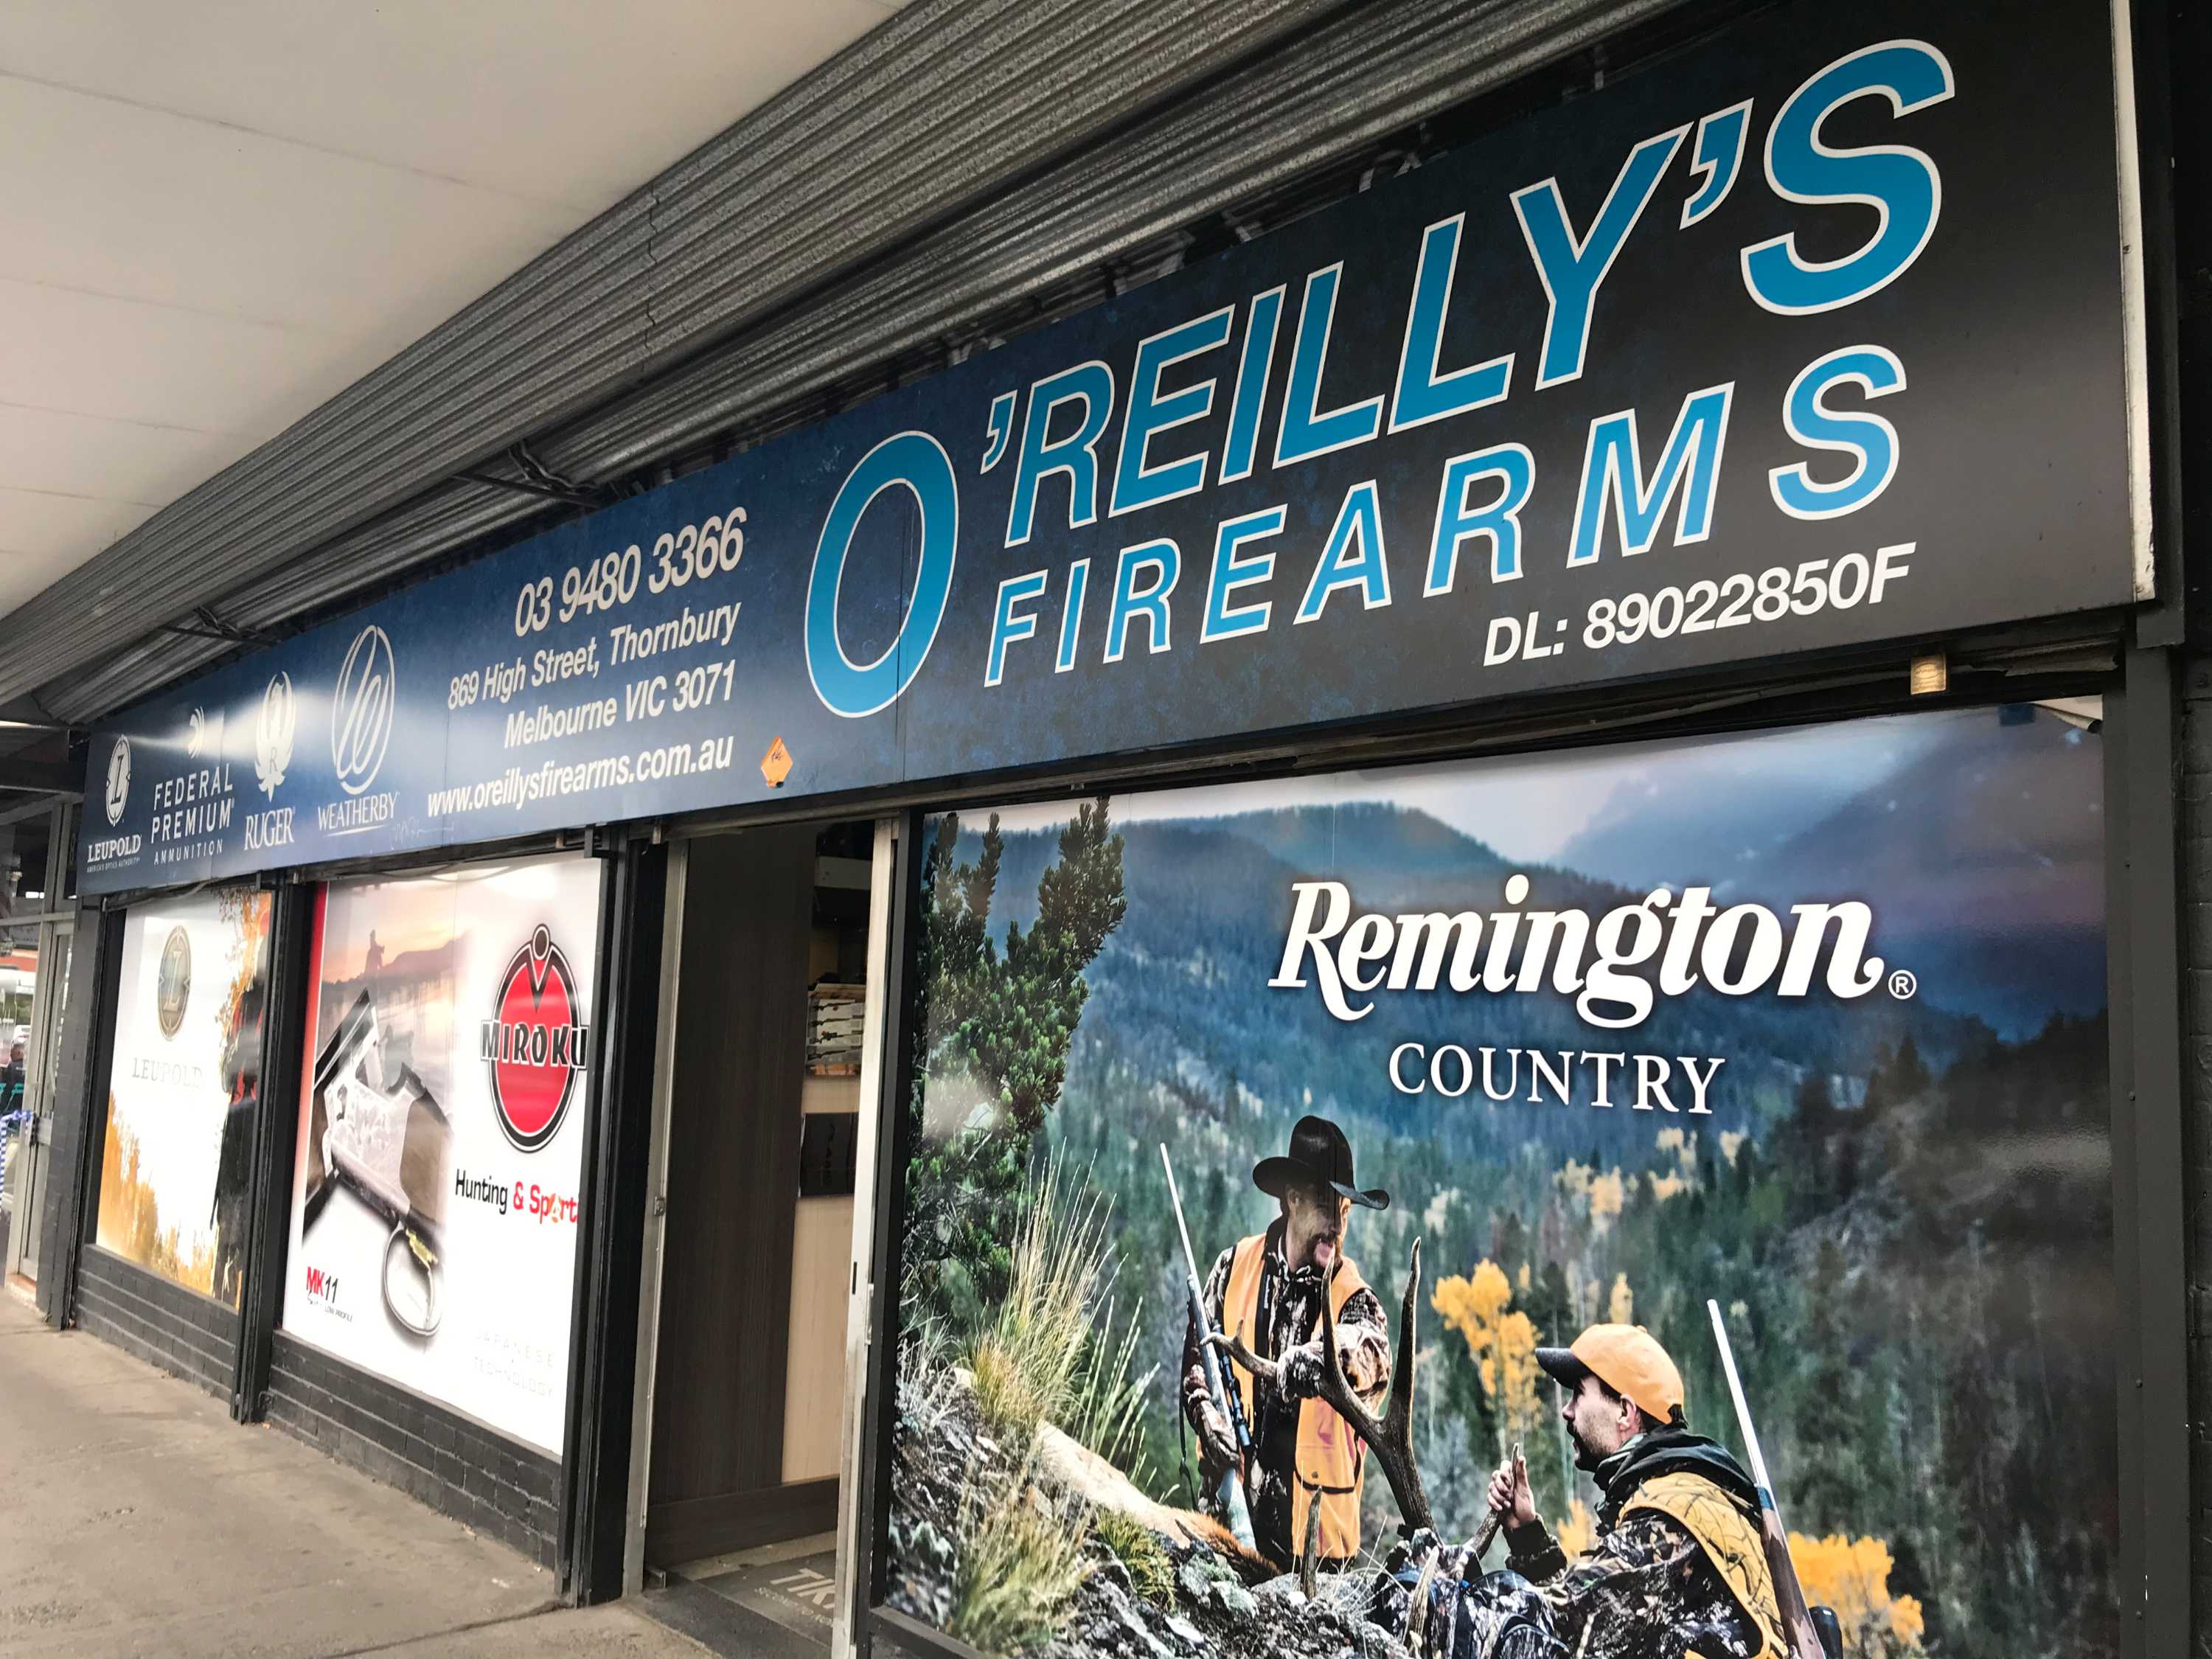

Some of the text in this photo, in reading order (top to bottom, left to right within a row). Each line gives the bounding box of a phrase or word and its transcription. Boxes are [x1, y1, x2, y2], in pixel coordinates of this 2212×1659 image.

[804, 38, 1955, 719] O'REILLY'S
[983, 344, 1907, 688] FIREARMS
[515, 507, 747, 636] 03 9480 3366
[1483, 542, 1916, 667] DL: 89022850F
[448, 602, 742, 710] 869 High Street, Thornbury
[504, 659, 736, 749] Melbourne VIC 3071
[153, 763, 234, 811] FEDERAL
[427, 735, 734, 818] www.oreillysfirearms.com.au
[151, 799, 231, 844] PREMIUM
[244, 807, 295, 851] RUGER
[318, 791, 399, 831] WEATHERBY
[87, 834, 142, 863] LEUPOLD
[153, 838, 223, 866] AMMUNITION
[1267, 874, 1885, 1029] Remington
[132, 1057, 202, 1088] LEUPOLD
[480, 1019, 589, 1071] MIROKU
[1388, 1041, 1726, 1115] COUNTRY
[455, 1168, 508, 1215] Hunting
[513, 1181, 524, 1211] &
